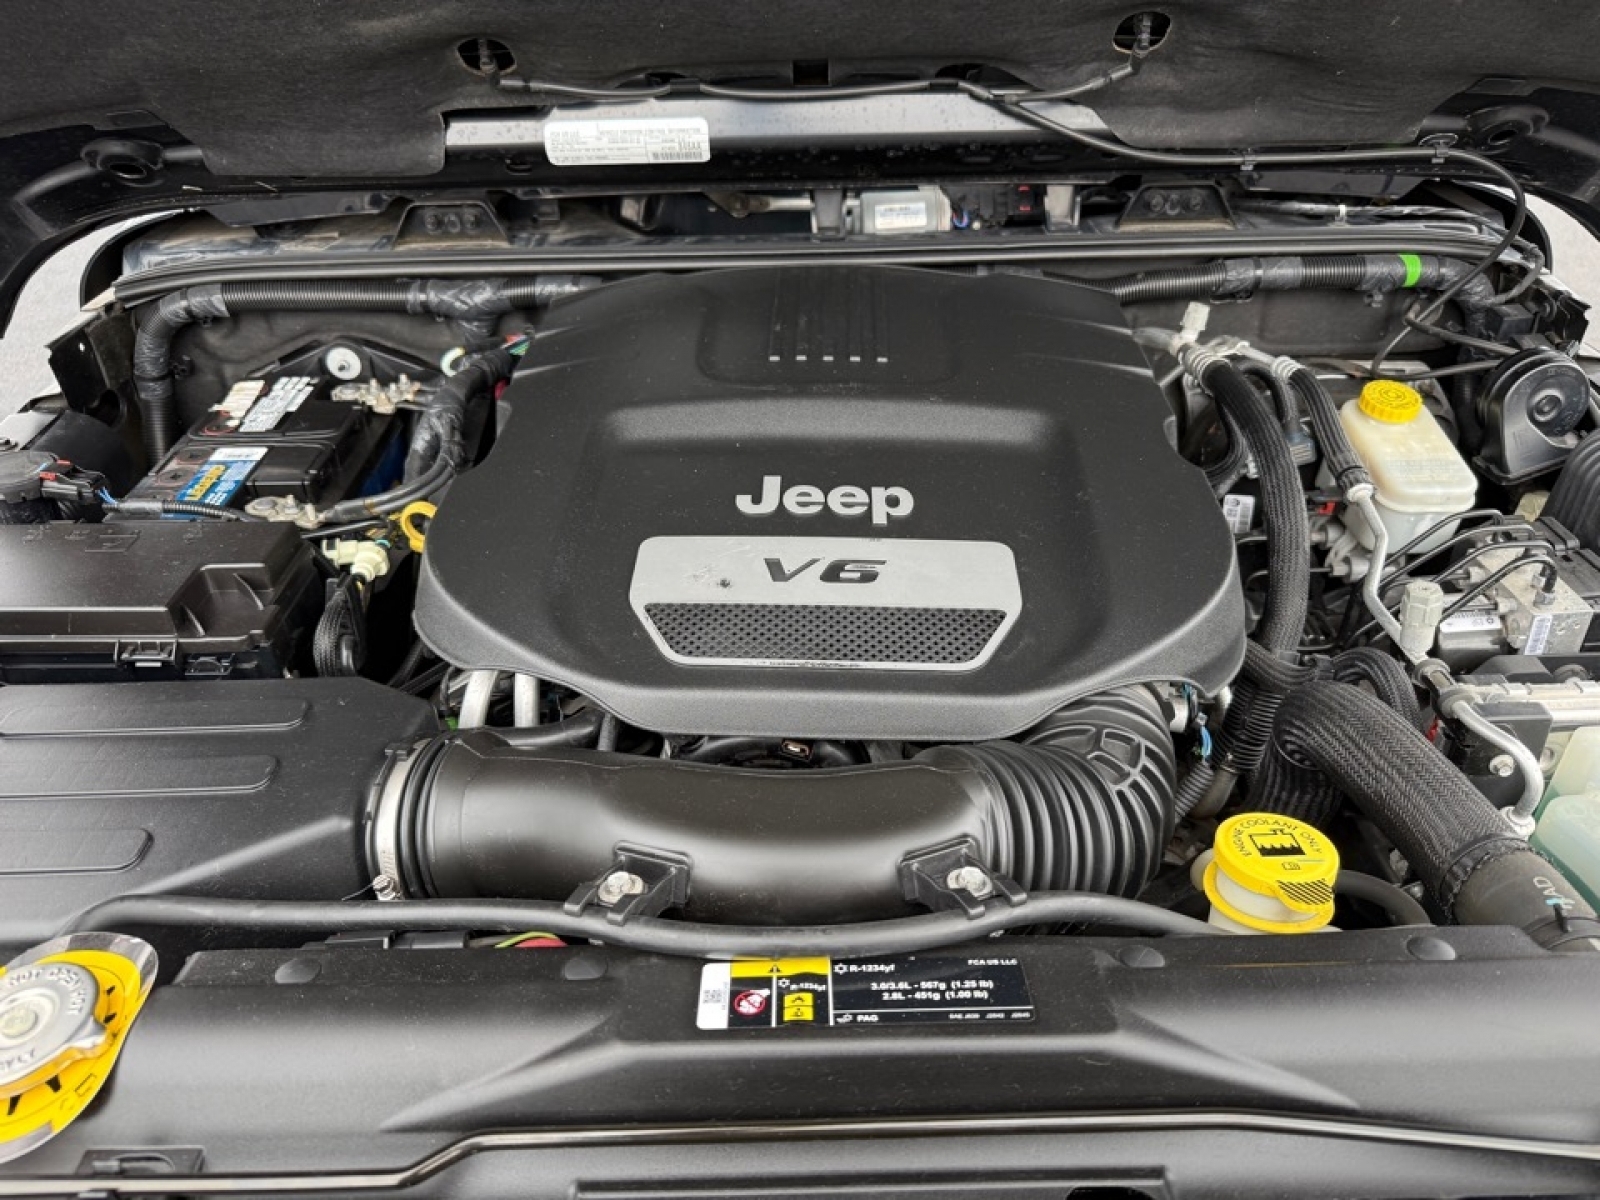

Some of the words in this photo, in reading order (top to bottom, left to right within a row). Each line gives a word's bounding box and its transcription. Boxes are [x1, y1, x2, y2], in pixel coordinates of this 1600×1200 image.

[734, 474, 915, 526] Jeep
[763, 557, 888, 584] V6
[1240, 819, 1299, 831] COOLANT
[849, 963, 896, 975] R-1234yf
[920, 981, 946, 991] 567g
[951, 979, 977, 990] (1.25
[978, 979, 994, 989] lb)
[914, 991, 941, 1001] 451g
[972, 989, 988, 1000] lb)
[856, 1013, 880, 1023] PAG
